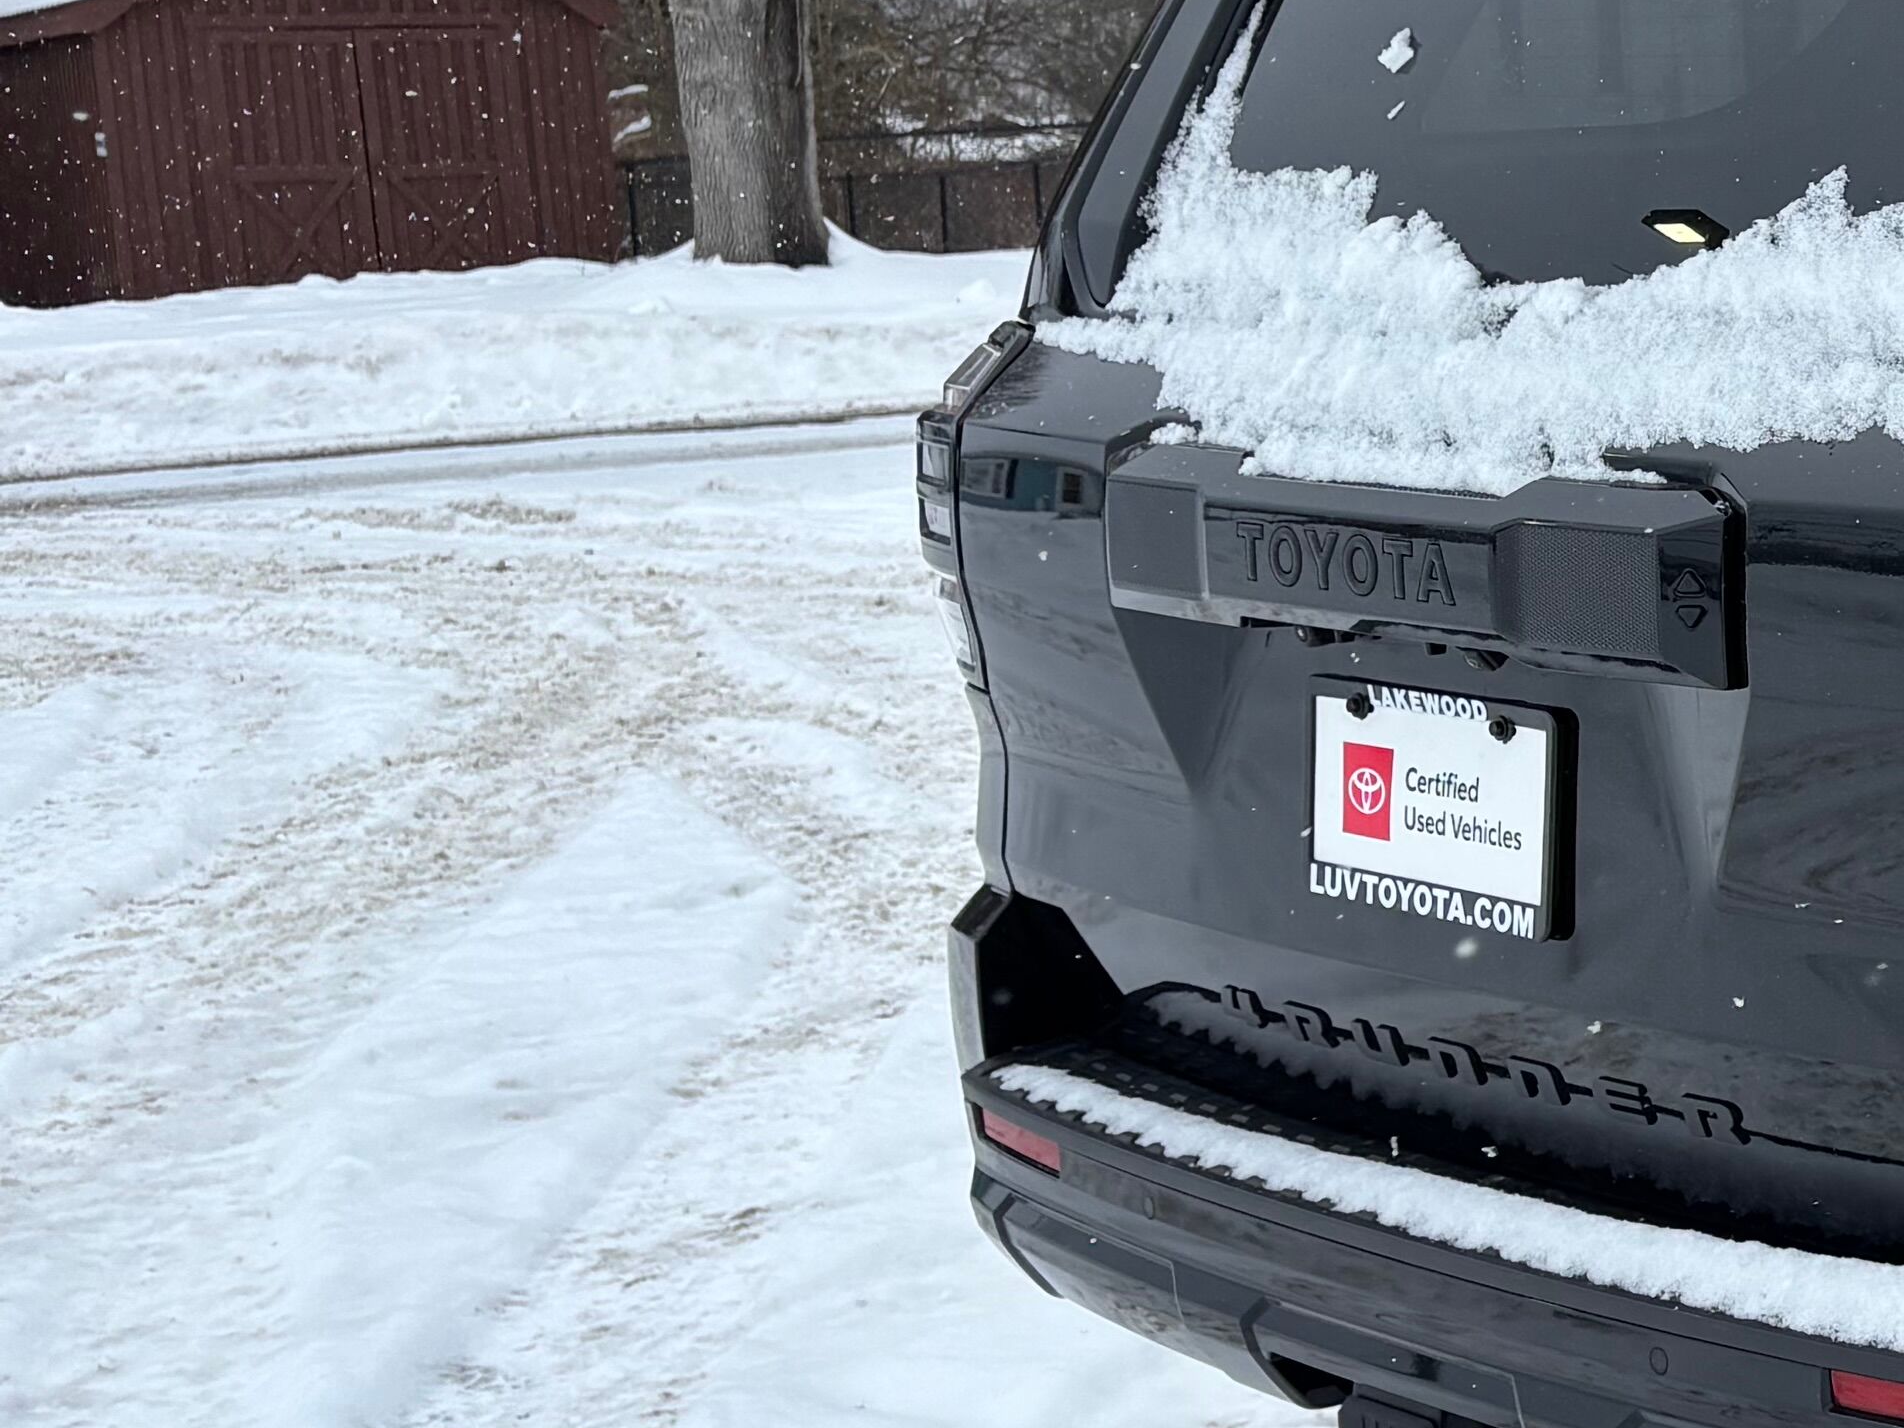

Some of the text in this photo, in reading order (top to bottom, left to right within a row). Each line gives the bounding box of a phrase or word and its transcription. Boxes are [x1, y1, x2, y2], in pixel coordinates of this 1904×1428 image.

[1236, 521, 1456, 607] TOYOTA
[1367, 684, 1488, 722] LAKEWOOD
[1405, 767, 1480, 803] Certified
[1404, 804, 1522, 850] Used Vehicles
[1310, 863, 1535, 939] LUVTOYOTA.COM
[1219, 984, 1752, 1146] 4RUNNER
